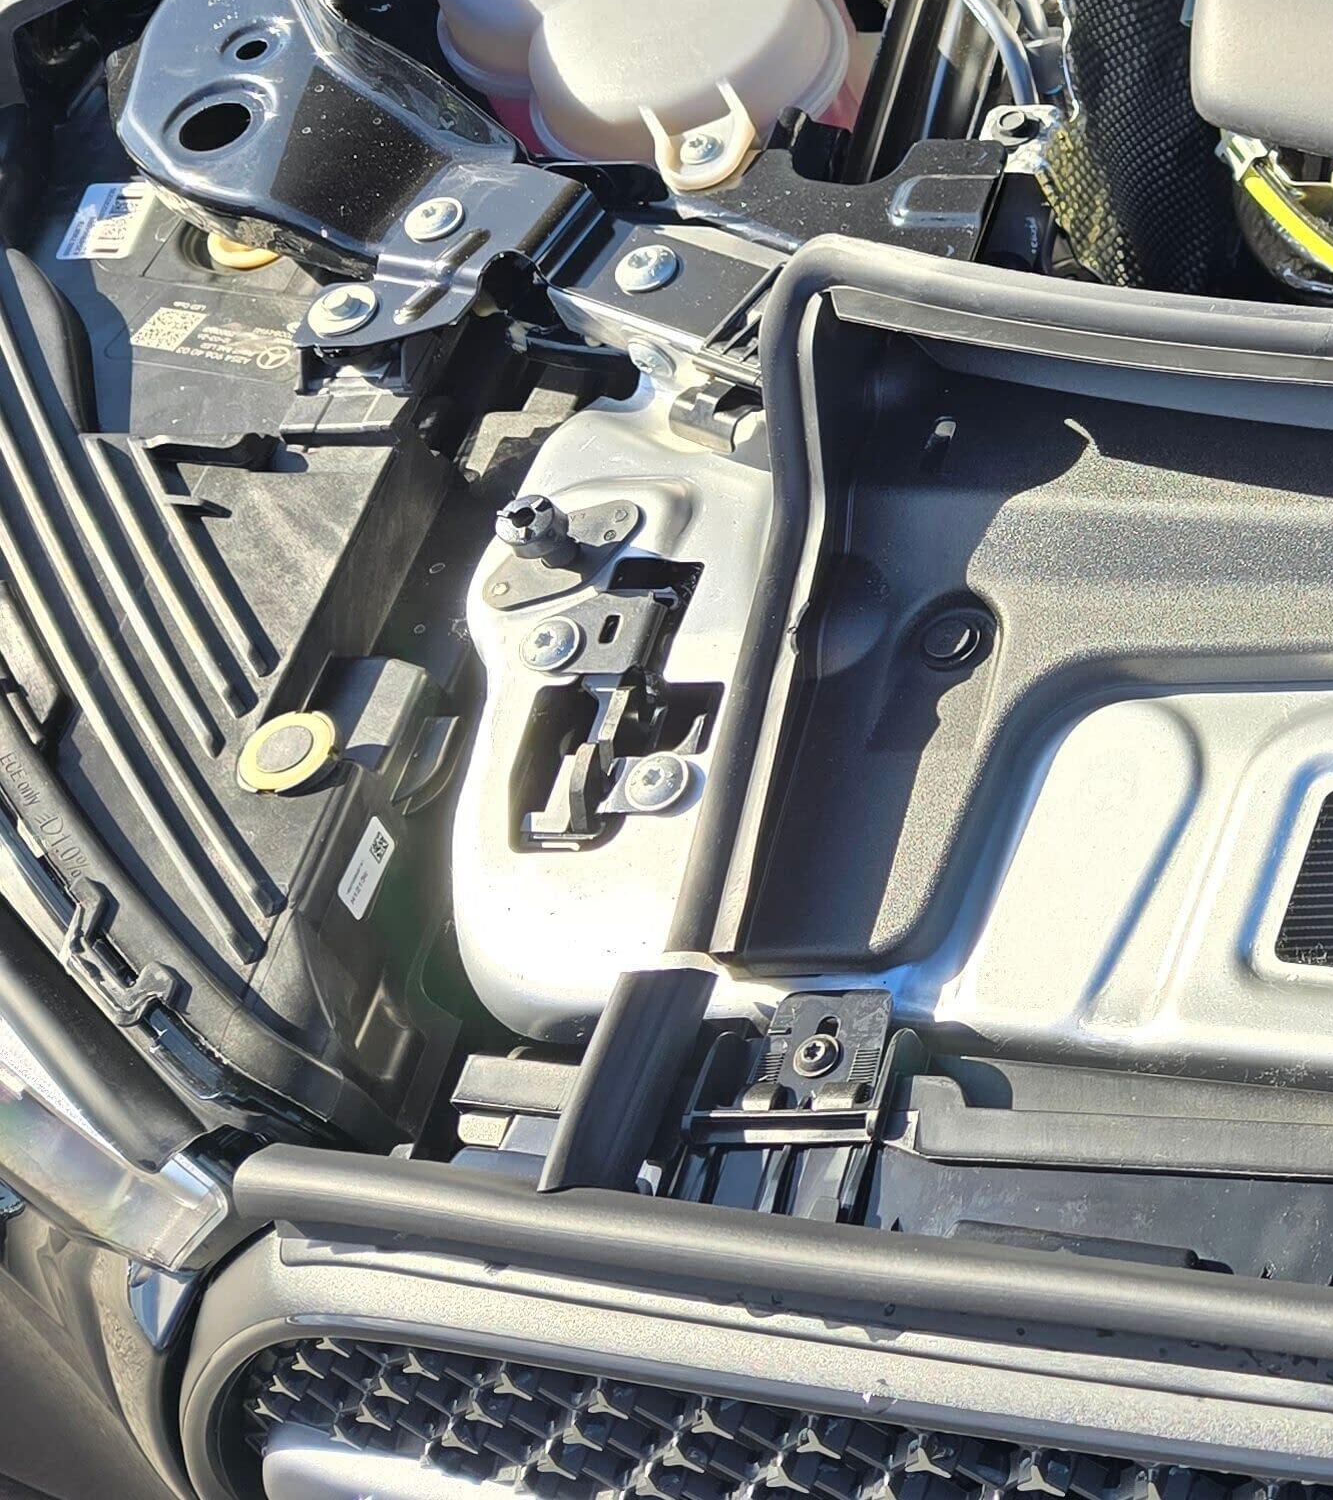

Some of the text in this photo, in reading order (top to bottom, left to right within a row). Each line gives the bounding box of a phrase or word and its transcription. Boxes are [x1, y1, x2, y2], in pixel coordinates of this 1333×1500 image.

[0, 752, 41, 807] ECE only
[51, 834, 90, 878] 1.0%
